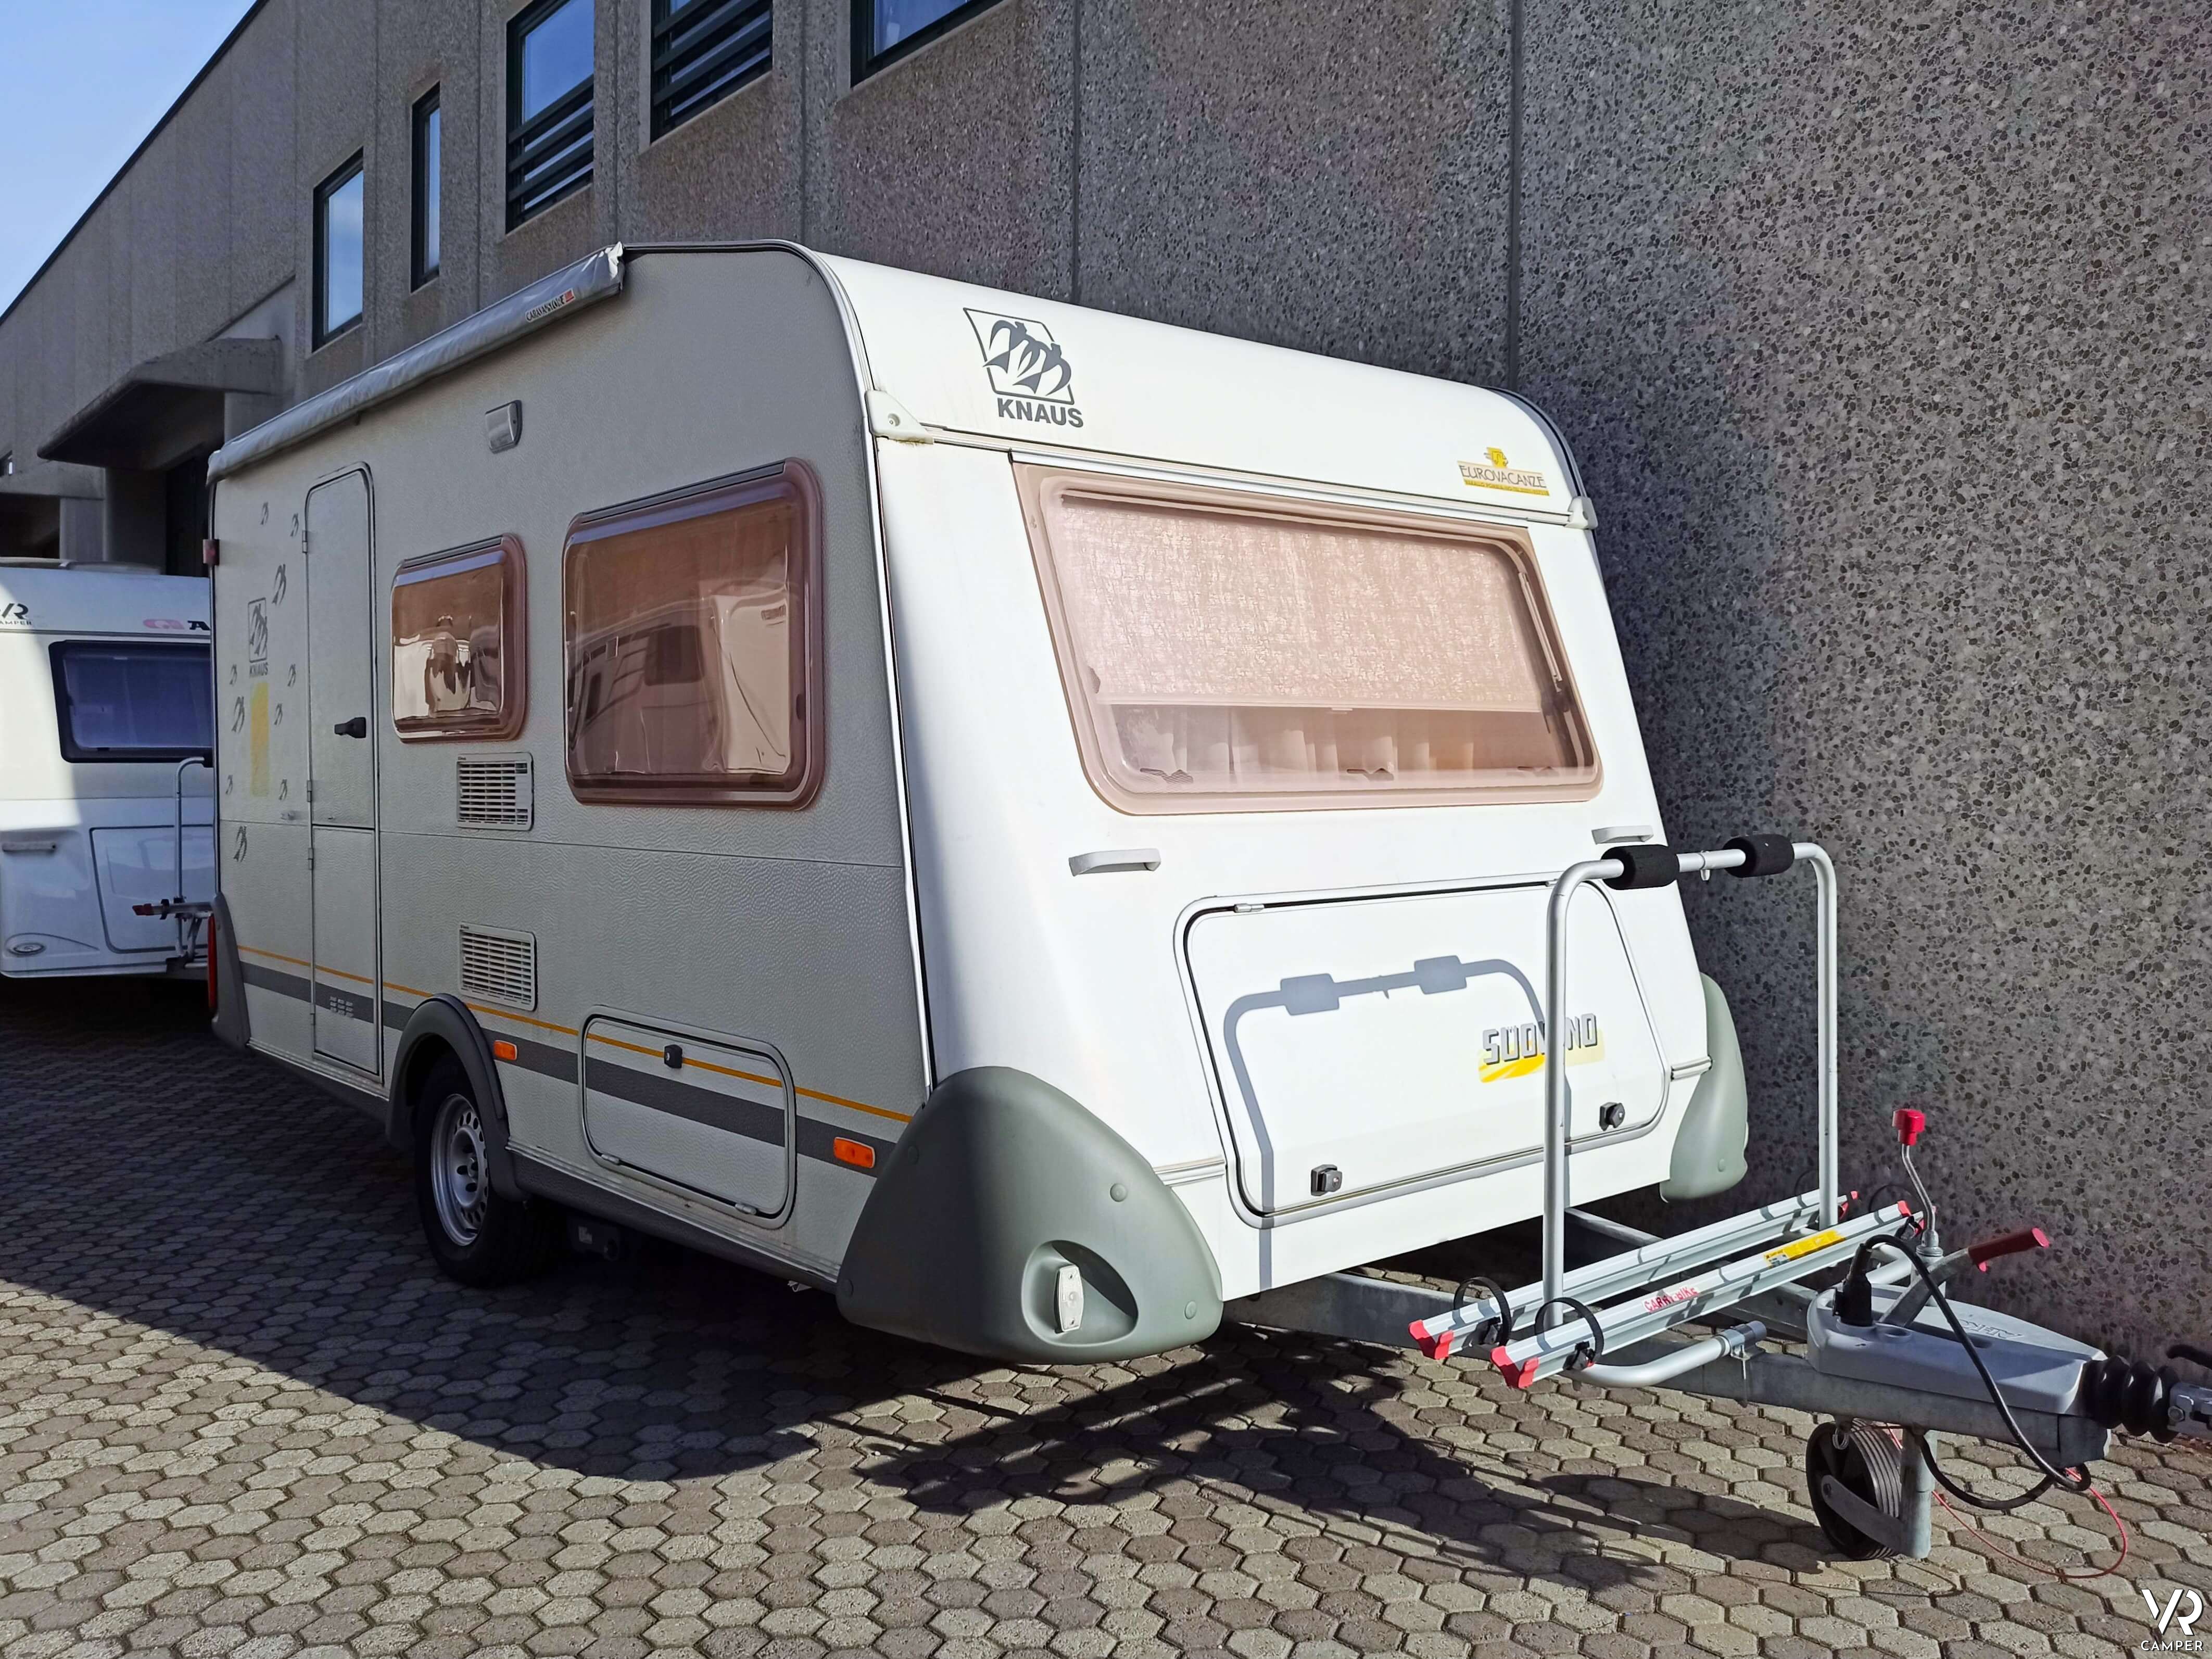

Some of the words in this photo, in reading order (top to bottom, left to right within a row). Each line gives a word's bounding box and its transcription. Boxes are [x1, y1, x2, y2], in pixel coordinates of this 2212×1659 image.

[997, 397, 1083, 427] KNAUS
[1459, 464, 1547, 488] EUROVACANZE
[1483, 1013, 1598, 1065] SÜDND
